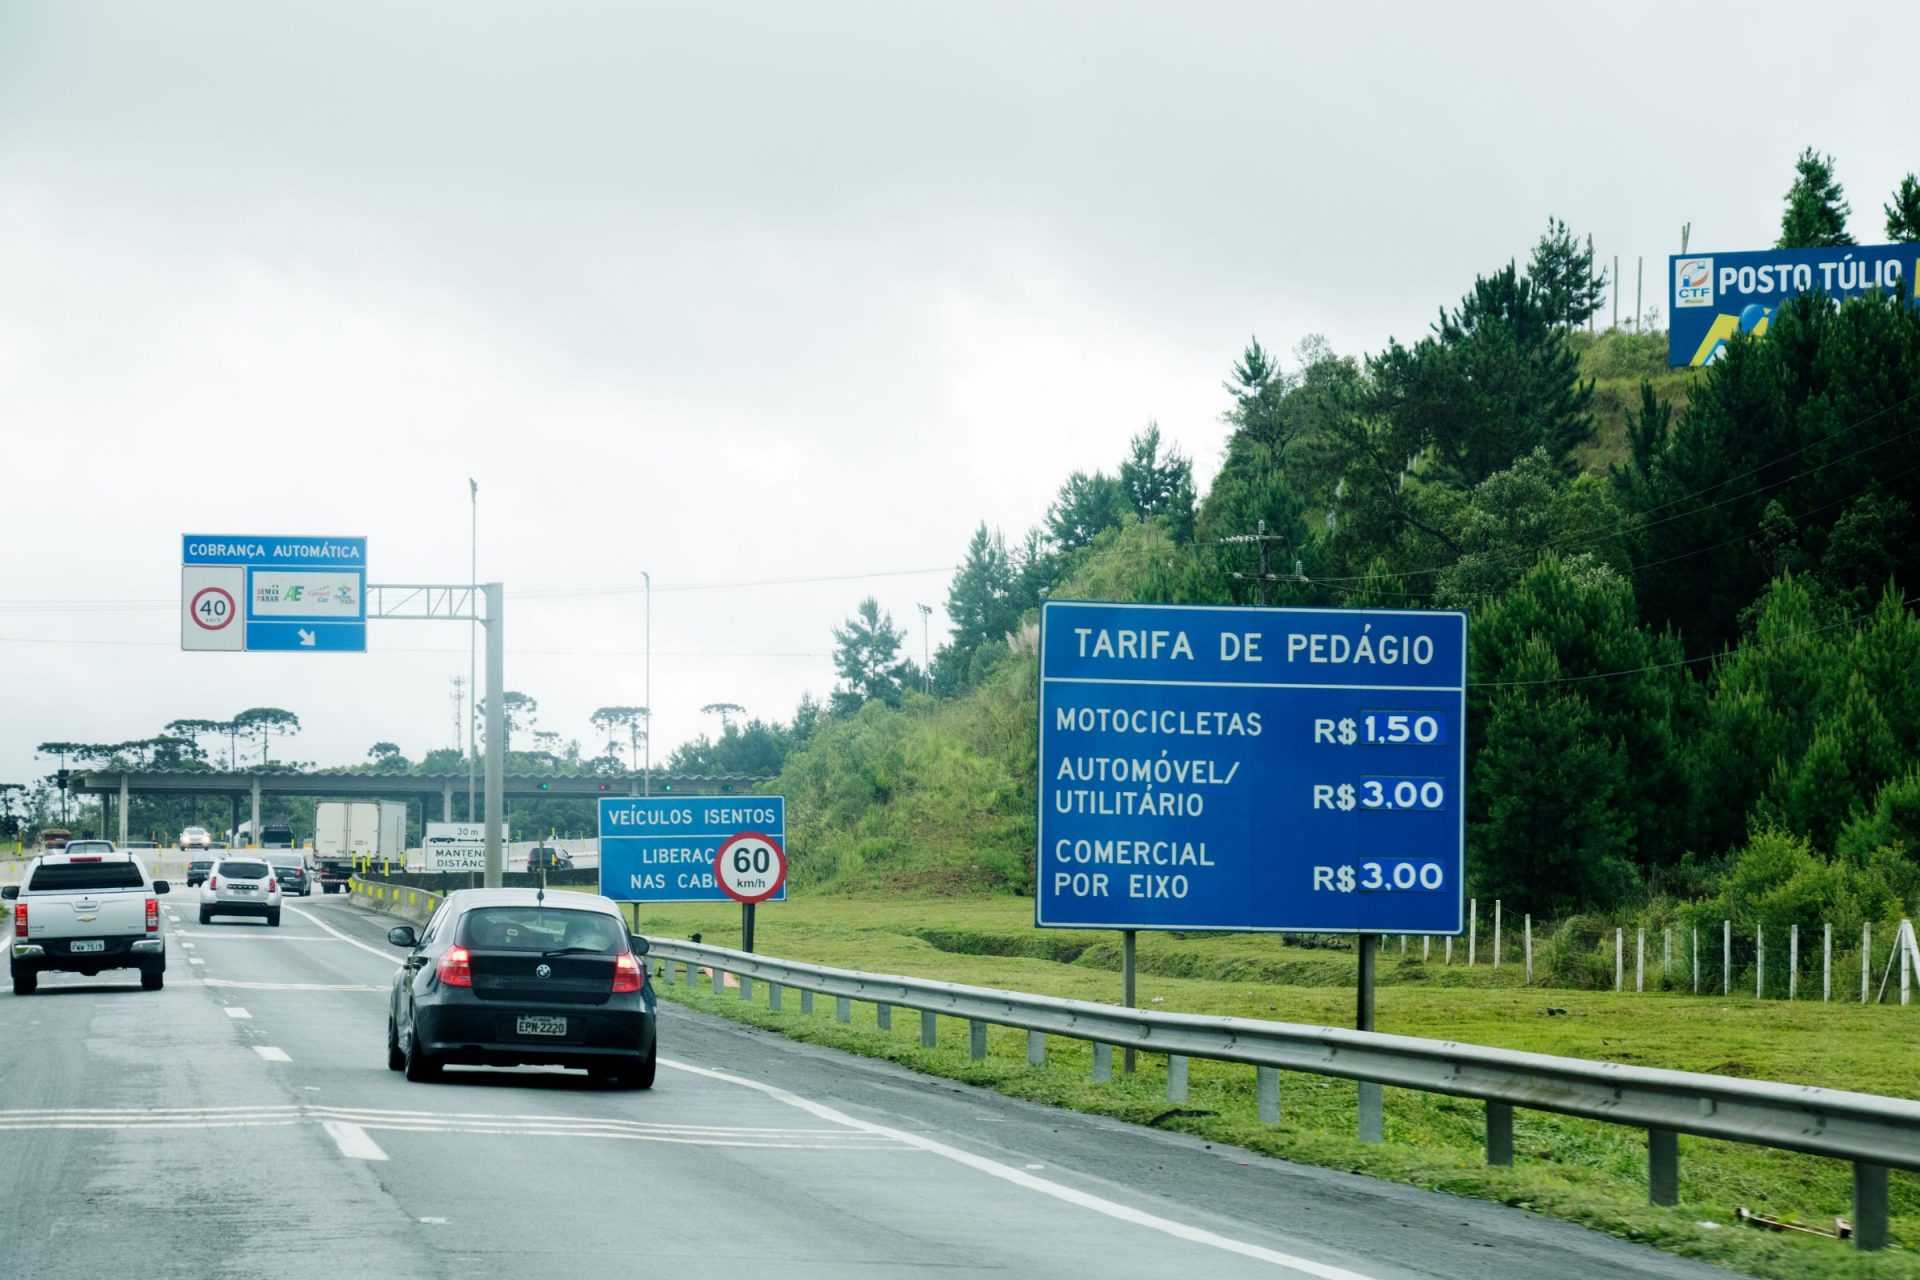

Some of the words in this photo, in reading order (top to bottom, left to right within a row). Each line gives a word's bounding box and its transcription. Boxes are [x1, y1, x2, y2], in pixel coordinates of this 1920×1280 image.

[1719, 263, 1812, 296] POSTO
[1818, 253, 1903, 290] TÚLIO
[1678, 287, 1710, 299] CTF
[189, 543, 266, 559] COBRANÇA
[273, 541, 360, 559] AUTOMÁTICA
[200, 600, 226, 616] 40
[1074, 628, 1195, 660] TARIFA
[1220, 632, 1263, 662] DE
[1287, 624, 1434, 665] PEDÁGIO
[1056, 708, 1262, 736] MOTOCICLETAS
[1056, 750, 1240, 785] AUTOMÓVEL/
[1055, 784, 1204, 817] UTILITÁRIO
[608, 804, 693, 825] VEÍCULOS
[704, 809, 775, 824] ISENTOS
[457, 828, 469, 836] 30
[733, 847, 770, 873] 60
[1055, 839, 1215, 866] COMERCIAL
[630, 874, 666, 889] NAS
[736, 878, 766, 889] km/h
[1055, 873, 1109, 897] POR
[1129, 874, 1189, 899] EIXO
